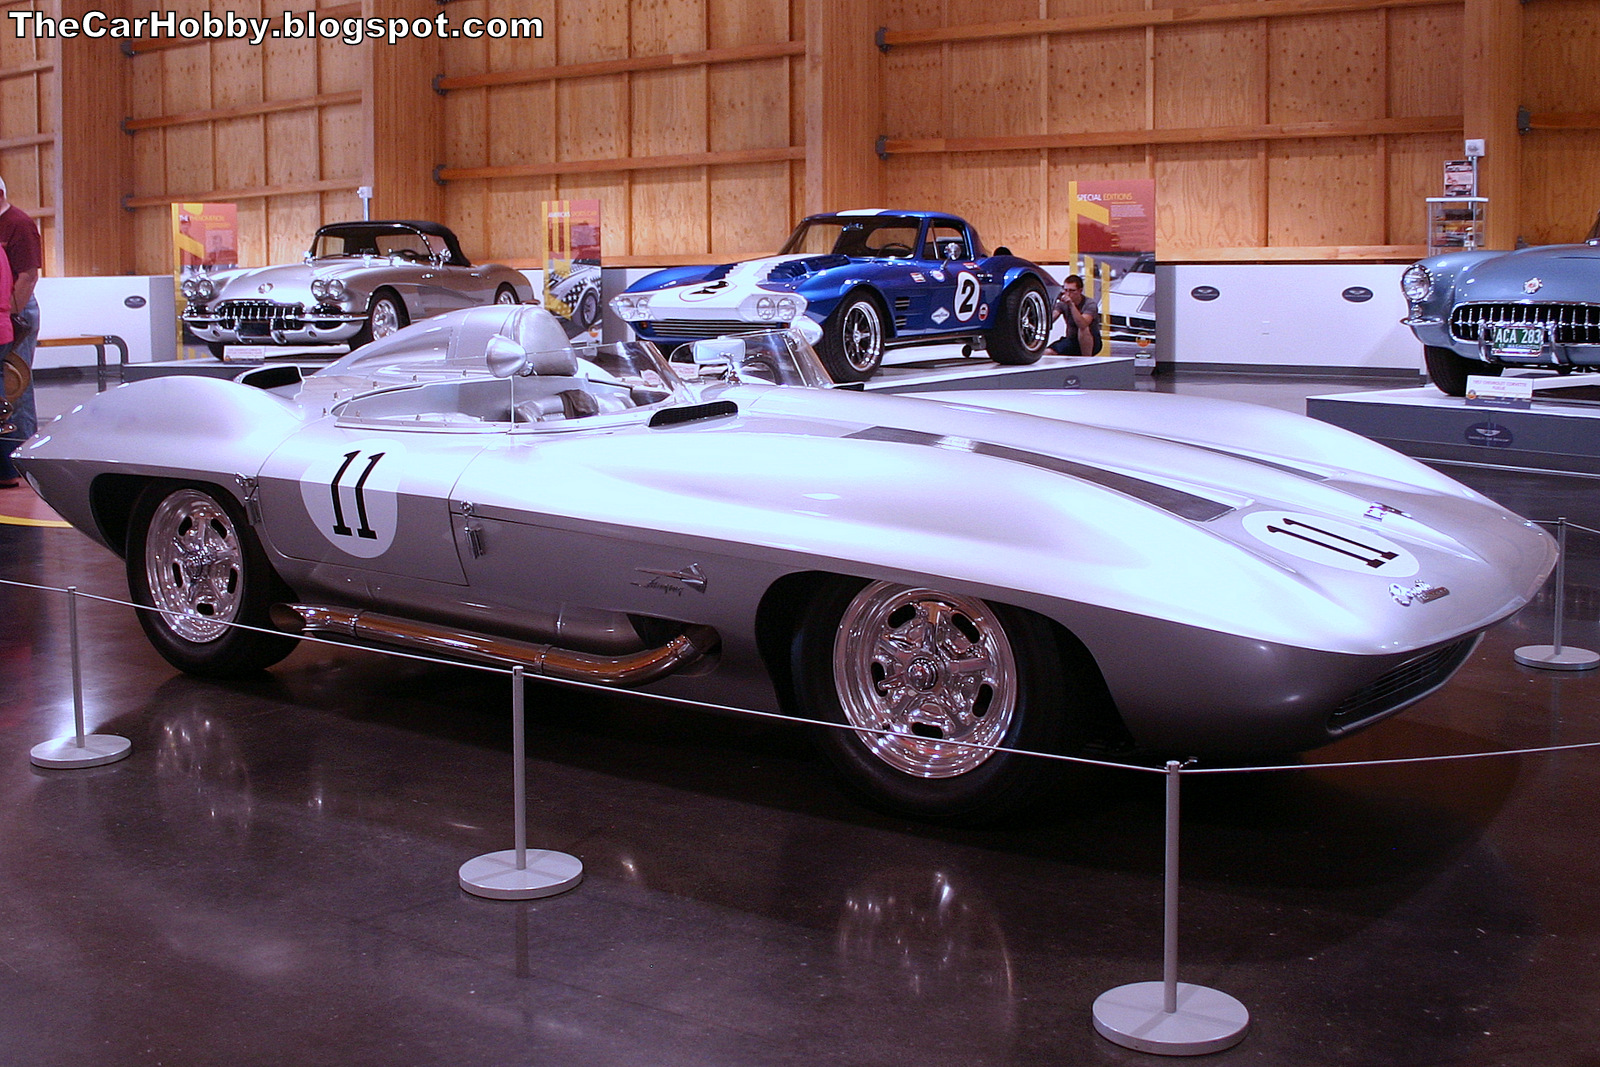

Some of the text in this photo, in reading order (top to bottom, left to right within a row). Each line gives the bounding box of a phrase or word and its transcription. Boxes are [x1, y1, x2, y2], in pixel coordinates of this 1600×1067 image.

[1077, 192, 1133, 201] SPECIAL EDITIONS
[959, 279, 976, 314] 2
[1495, 329, 1541, 344] ACA 283
[331, 449, 385, 540] 11
[1266, 517, 1399, 568] 11
